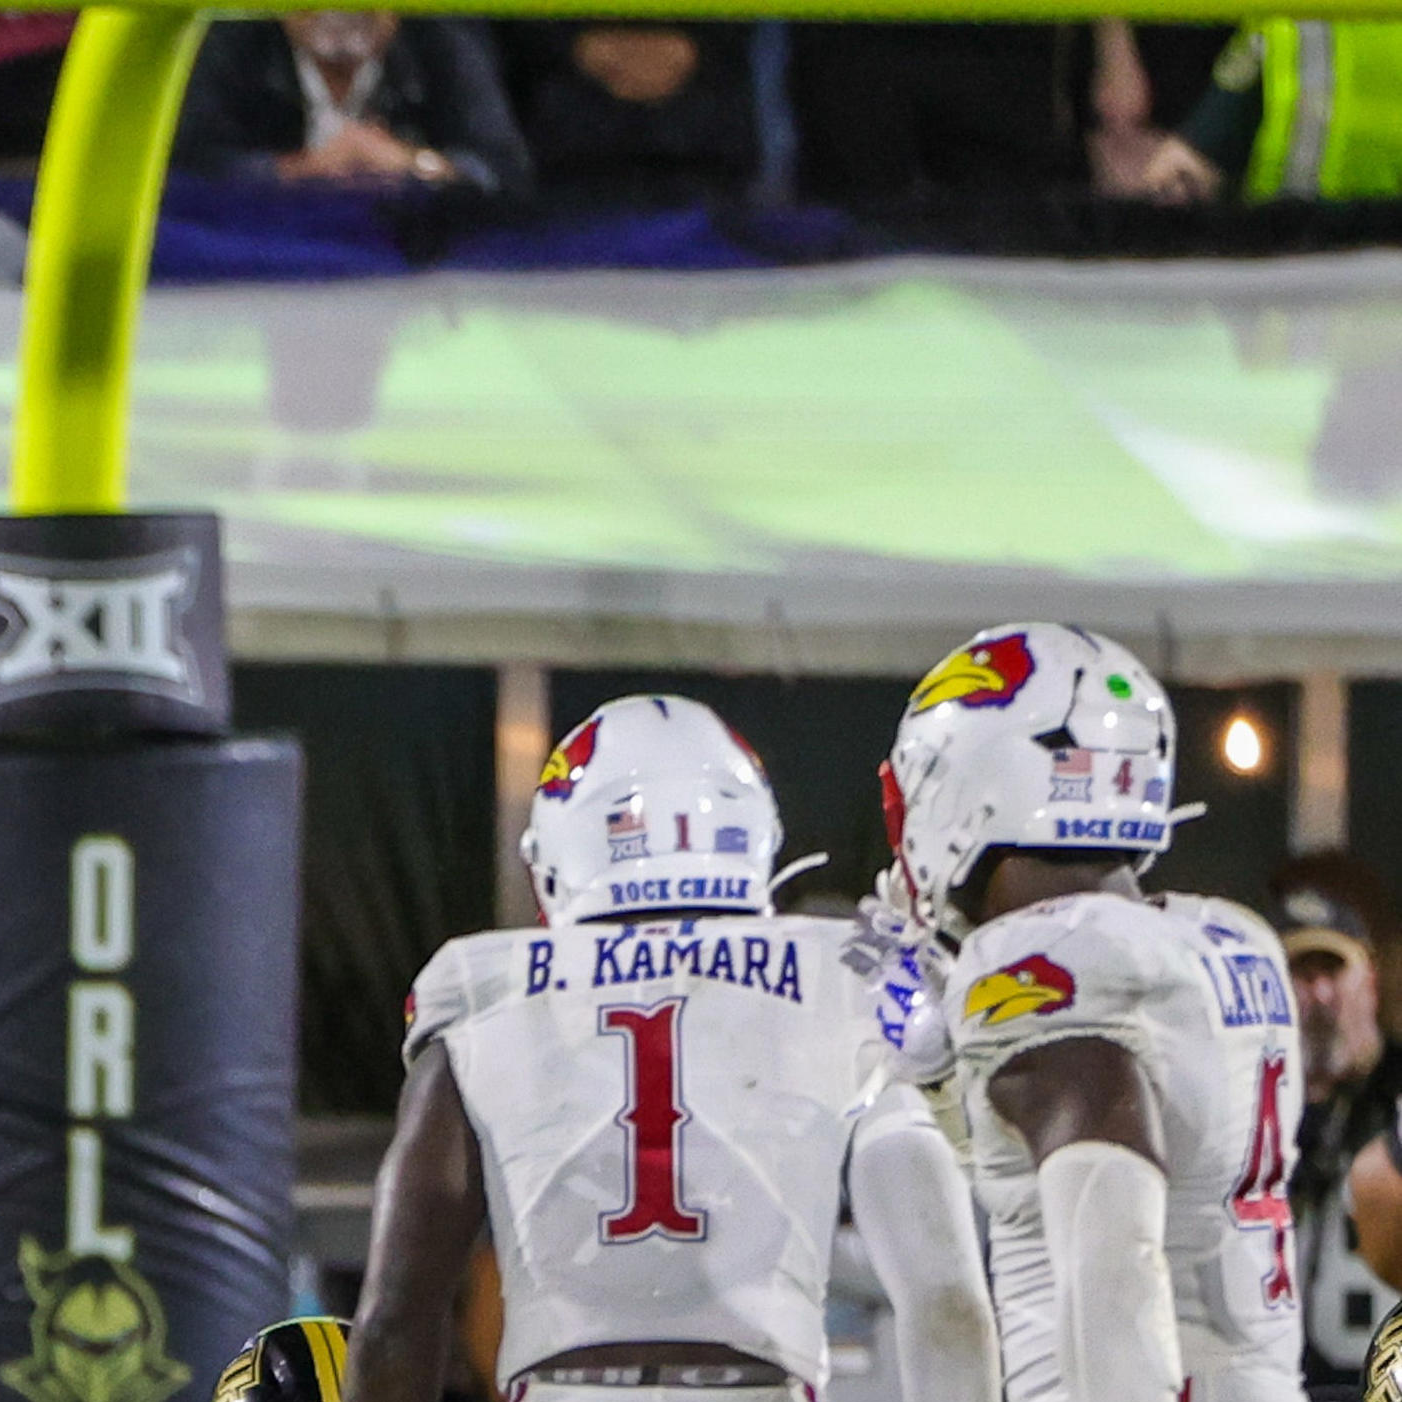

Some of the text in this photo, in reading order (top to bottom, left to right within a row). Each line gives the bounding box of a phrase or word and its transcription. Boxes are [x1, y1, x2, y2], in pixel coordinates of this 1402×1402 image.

[1112, 758, 1134, 796] 4
[673, 812, 691, 852] 1
[609, 876, 751, 904] ROCK CHALK
[525, 935, 803, 1004] B. KAMARA
[597, 996, 708, 1244] 1
[1224, 1047, 1297, 1312] 4
